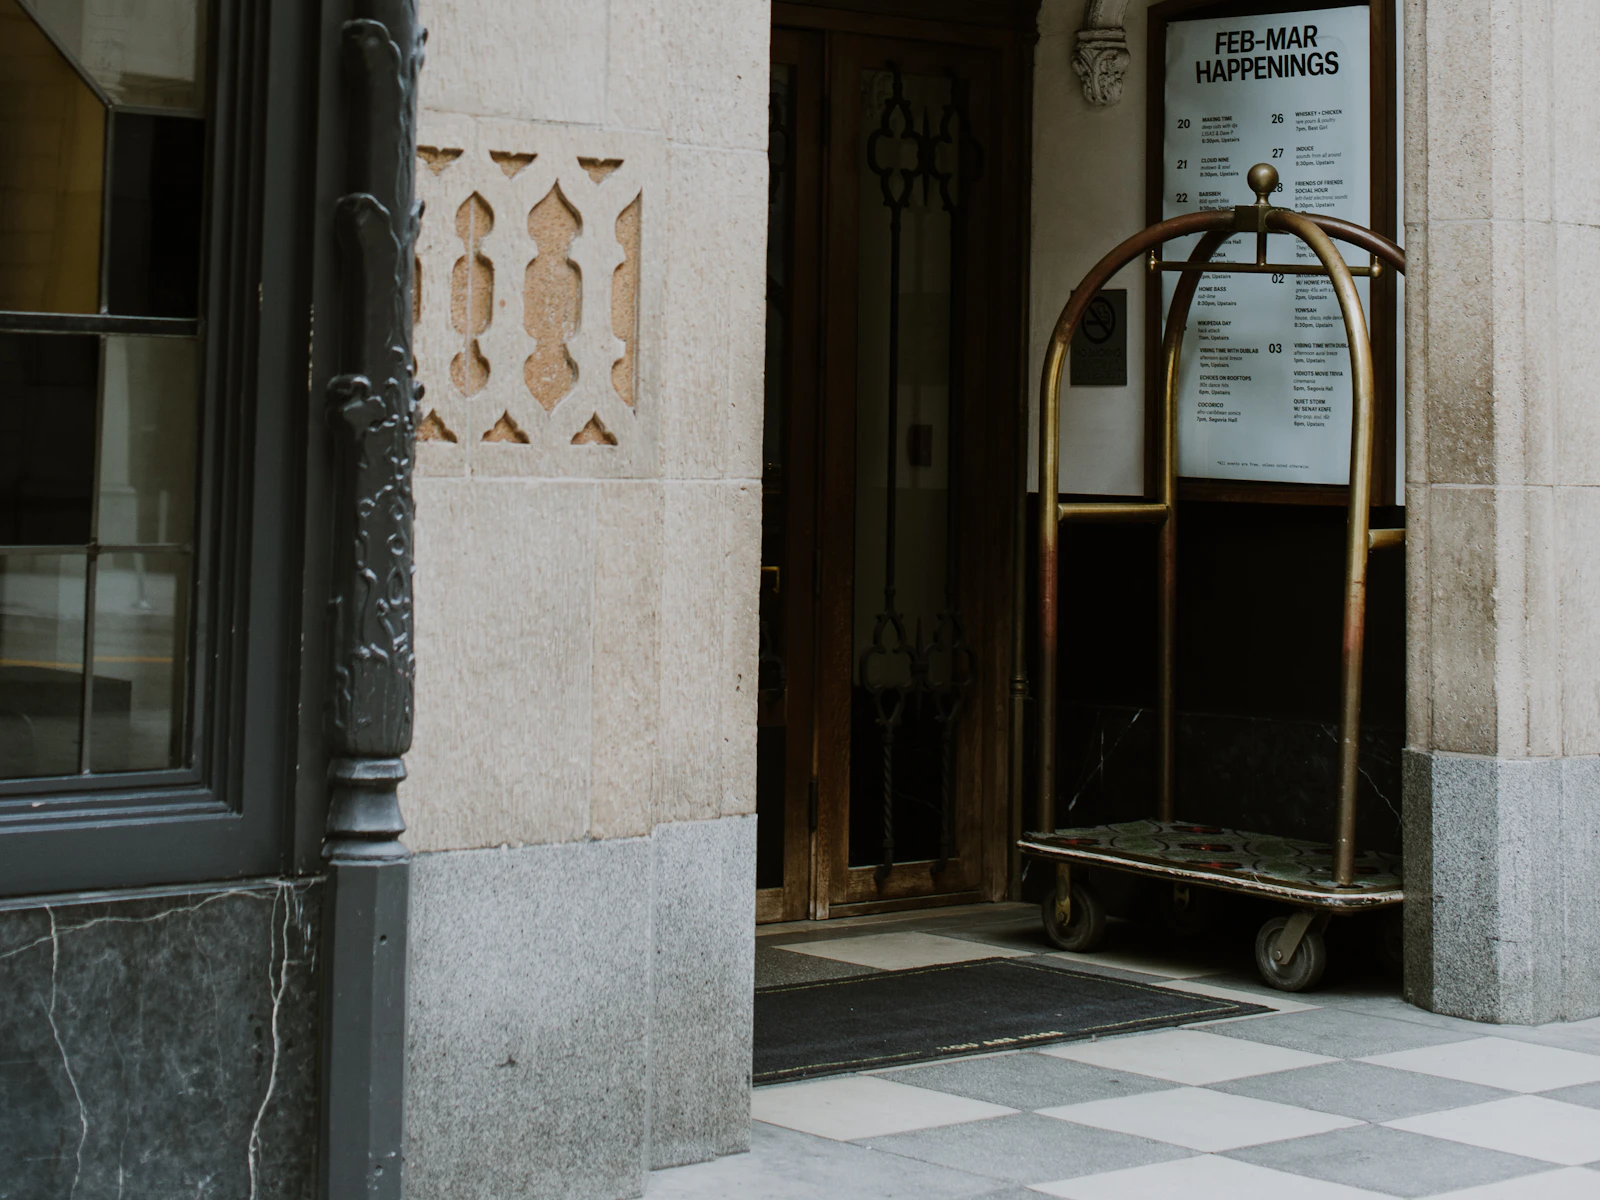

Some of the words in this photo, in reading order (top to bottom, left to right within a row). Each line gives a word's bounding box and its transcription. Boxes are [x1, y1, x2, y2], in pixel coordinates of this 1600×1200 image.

[1215, 25, 1317, 55] FEB-MAR
[1196, 51, 1339, 84] HAPPENINGS
[1271, 113, 1284, 123] 26
[1177, 119, 1190, 129] 20
[1272, 148, 1284, 158] 27
[1177, 159, 1187, 169] 21
[1273, 183, 1283, 192] 8
[1176, 193, 1188, 203] 22
[1272, 273, 1284, 284] 02
[1268, 343, 1282, 353] 03
